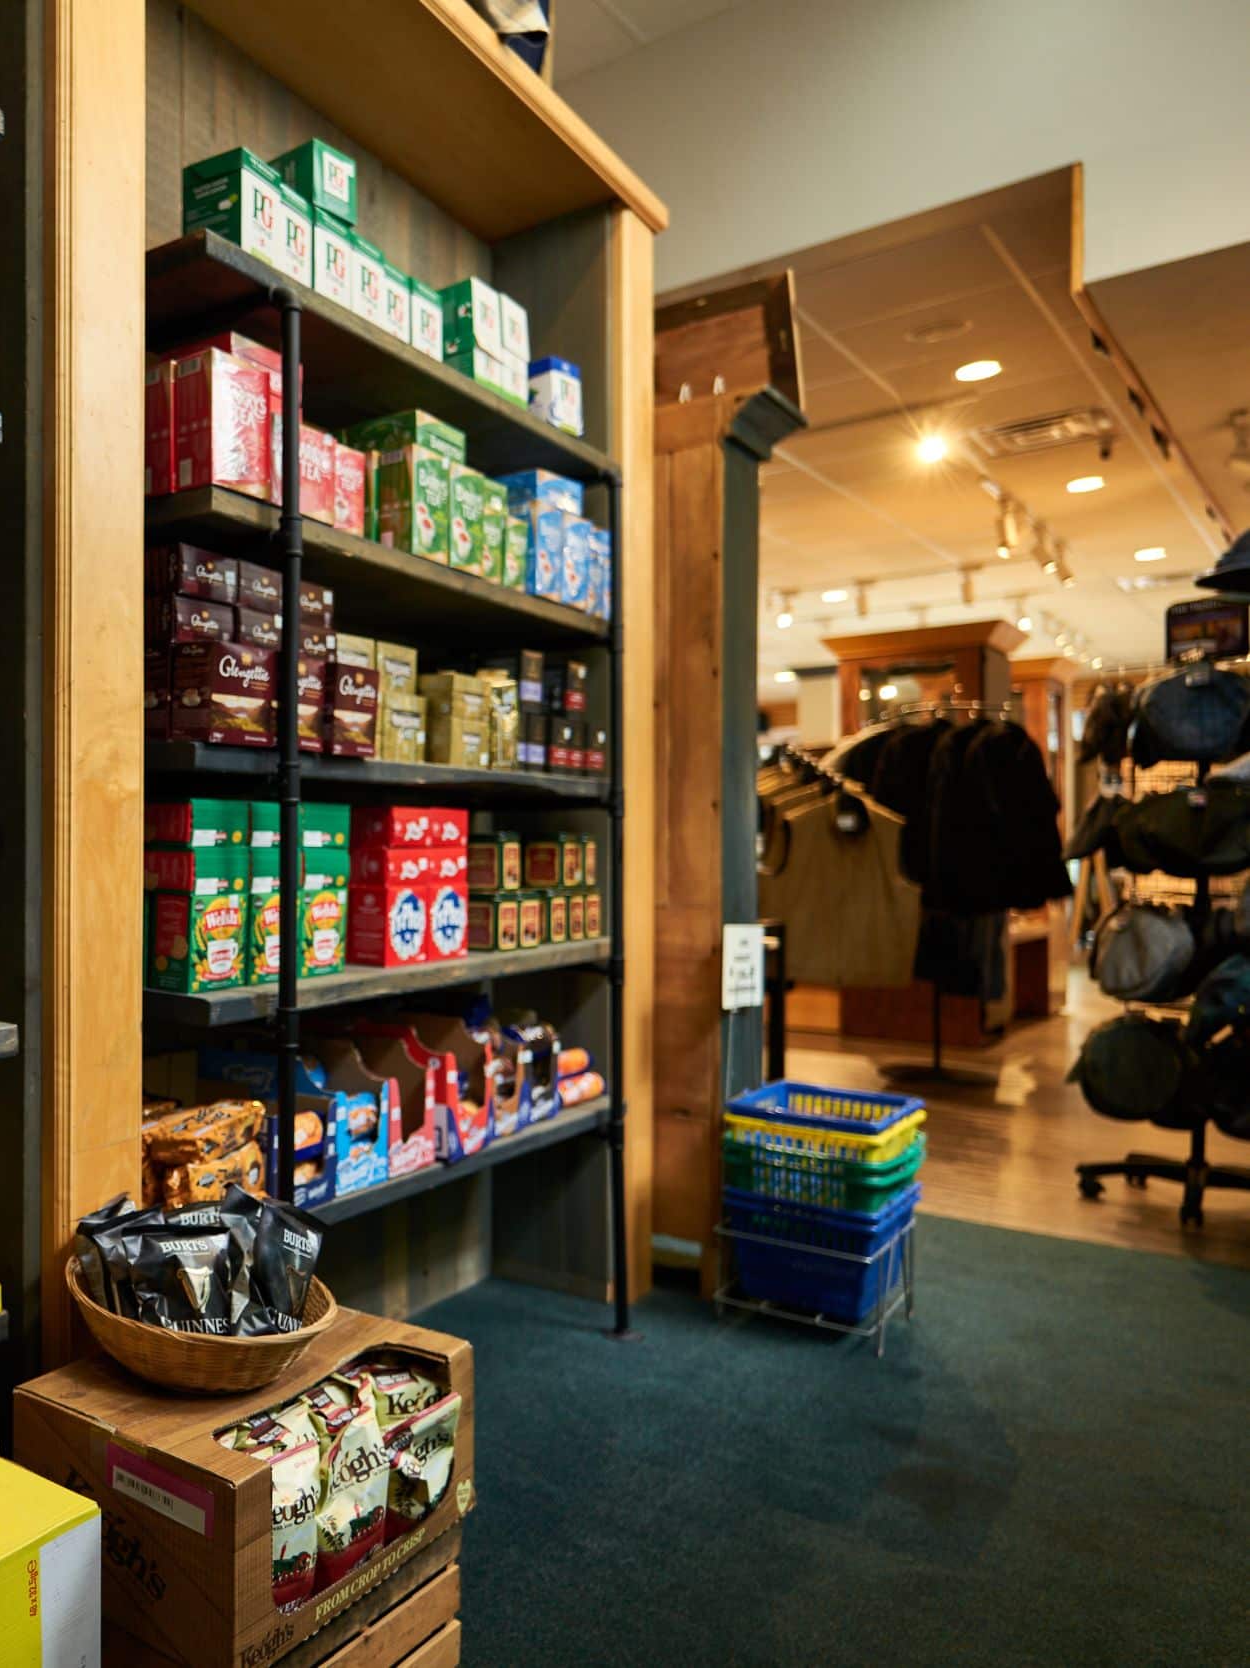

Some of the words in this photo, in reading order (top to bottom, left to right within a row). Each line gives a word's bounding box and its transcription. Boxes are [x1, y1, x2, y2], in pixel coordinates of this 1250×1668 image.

[159, 1240, 209, 1253] BURTS
[314, 1587, 351, 1621] FROM
[350, 1563, 381, 1596] CROP
[381, 1553, 397, 1576] TO
[396, 1527, 426, 1563] CRISP
